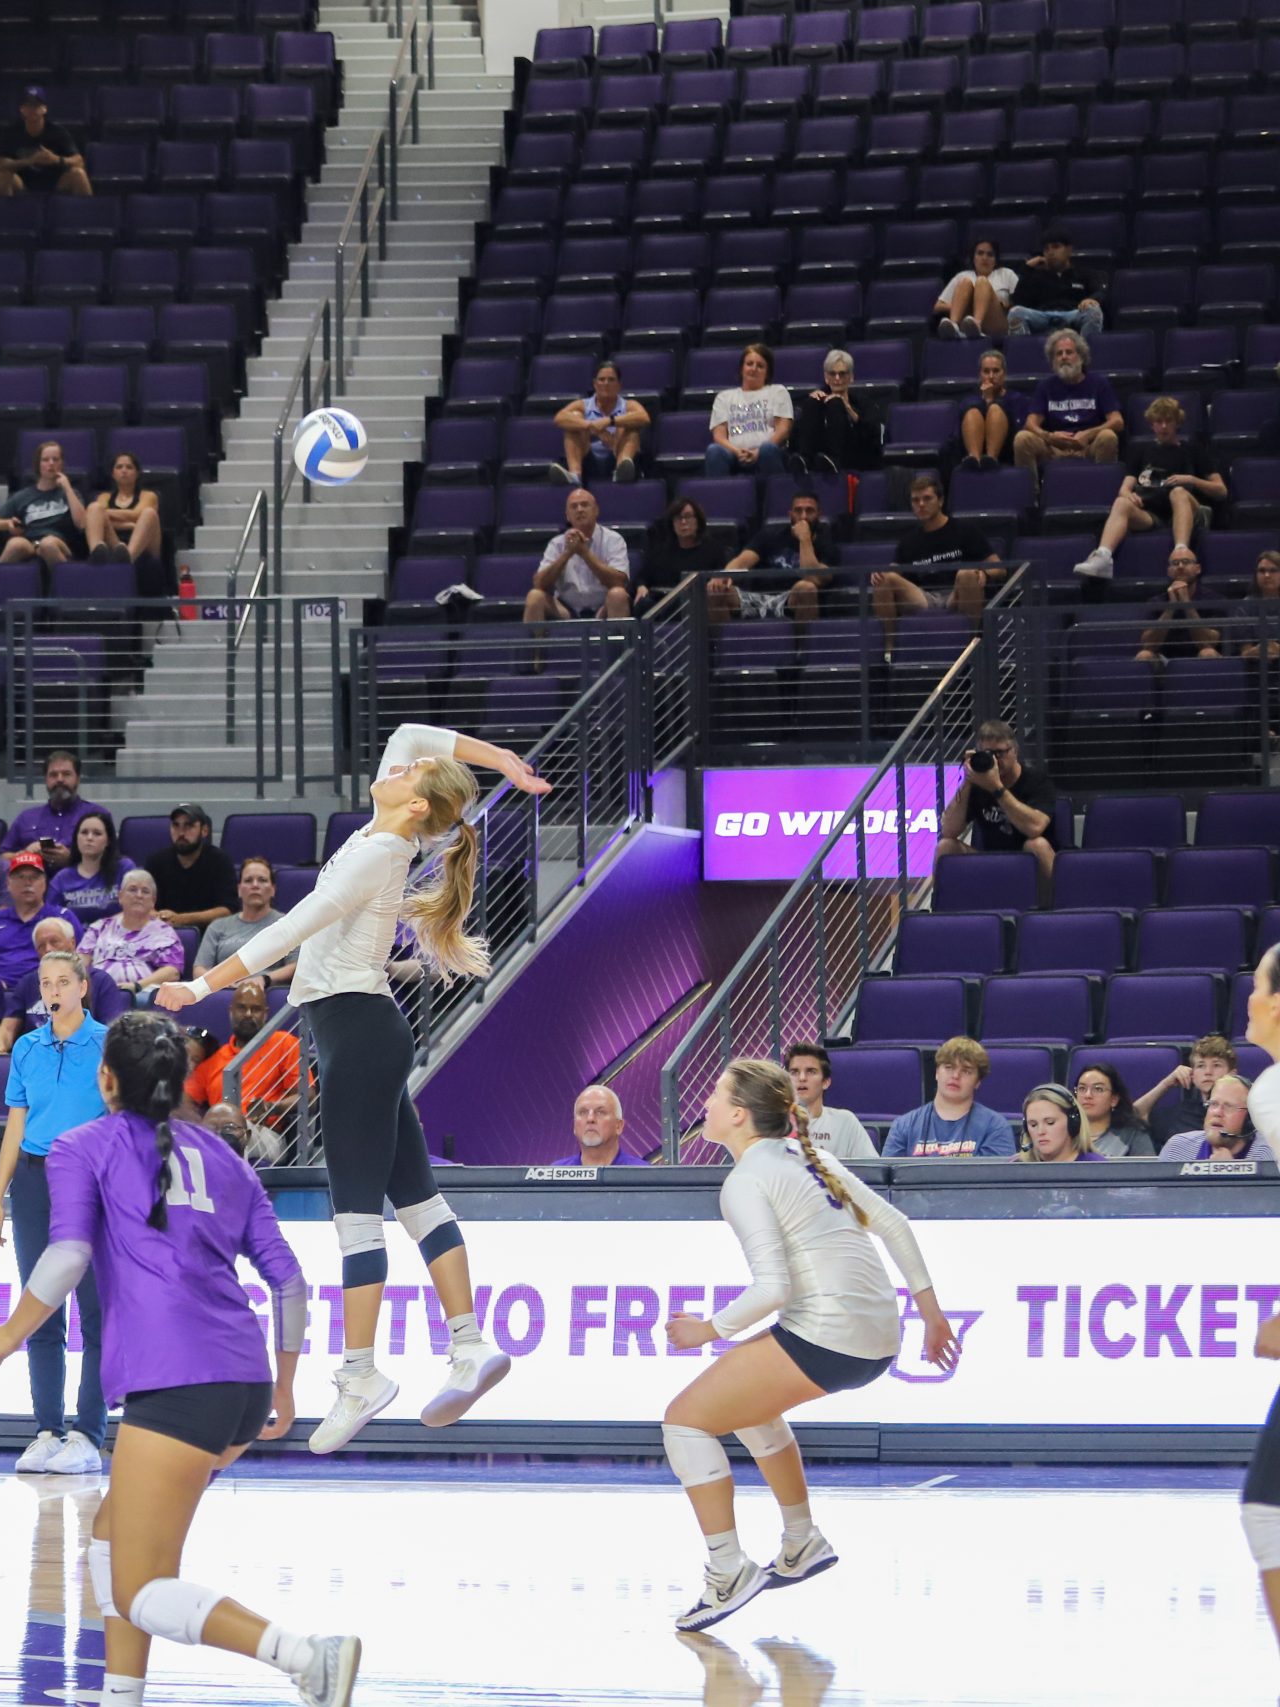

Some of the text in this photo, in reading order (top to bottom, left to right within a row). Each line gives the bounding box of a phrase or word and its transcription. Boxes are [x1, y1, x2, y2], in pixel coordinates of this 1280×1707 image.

[308, 605, 332, 617] 102
[715, 812, 769, 837] GO
[525, 1168, 595, 1180] ACE SPORTS
[1180, 1163, 1253, 1176] ACE SPORTS
[166, 1146, 215, 1213] 11
[384, 1282, 546, 1358] TWO
